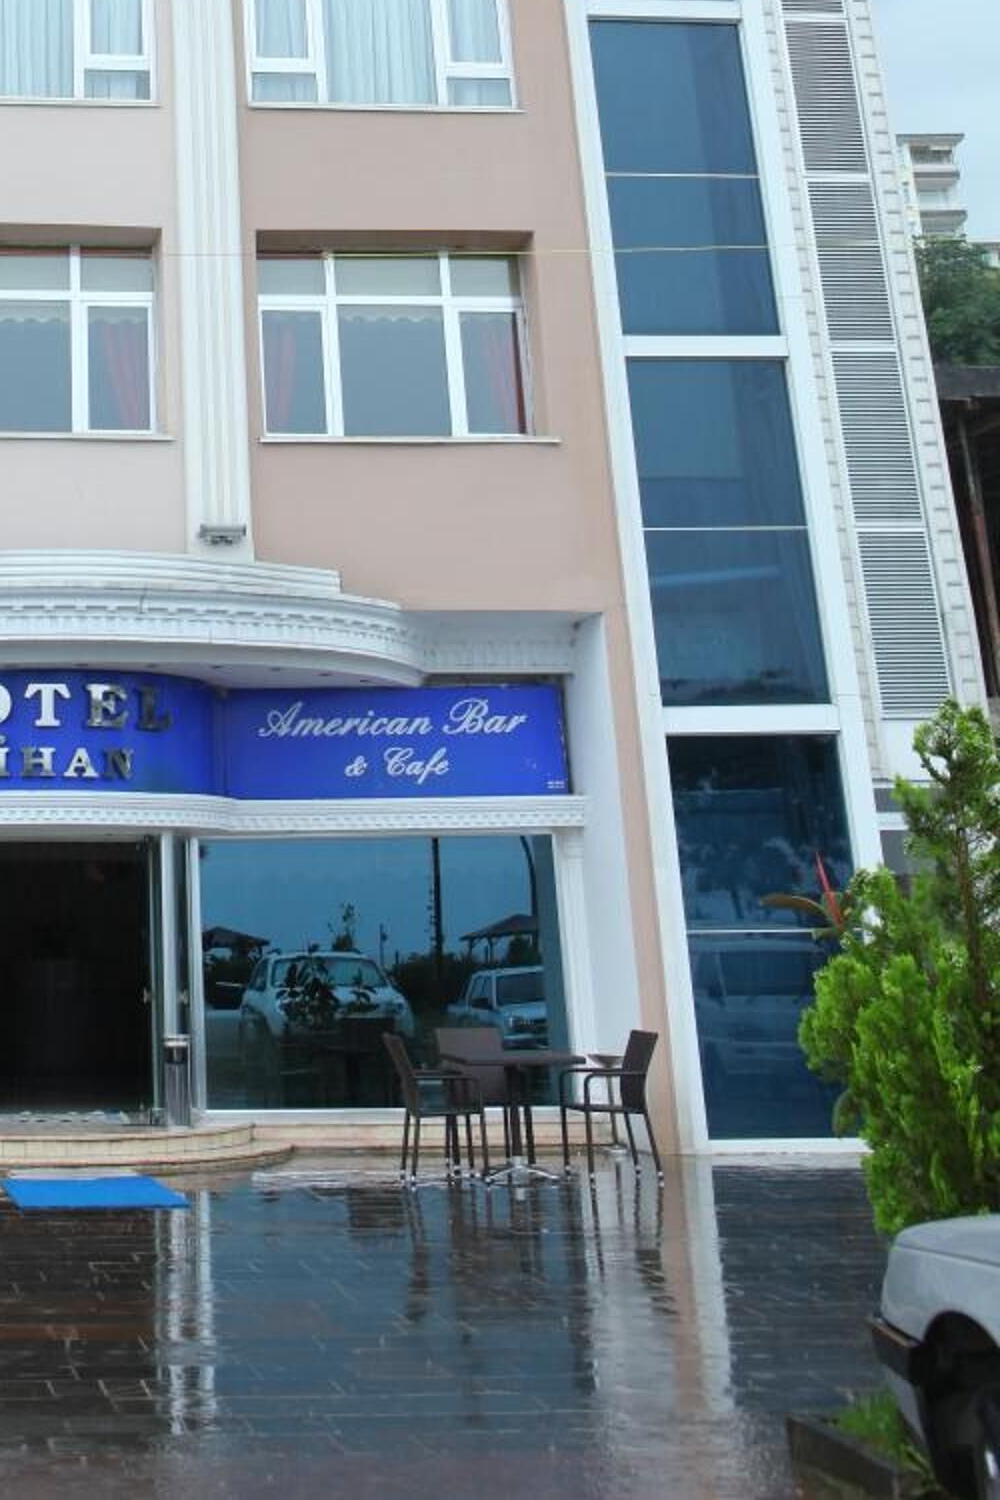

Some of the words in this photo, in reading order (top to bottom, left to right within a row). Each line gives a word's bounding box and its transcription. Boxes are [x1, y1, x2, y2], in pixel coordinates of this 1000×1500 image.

[258, 702, 433, 738] American
[442, 698, 526, 735] Bar
[344, 755, 367, 777] &
[384, 747, 450, 785] Cafe
